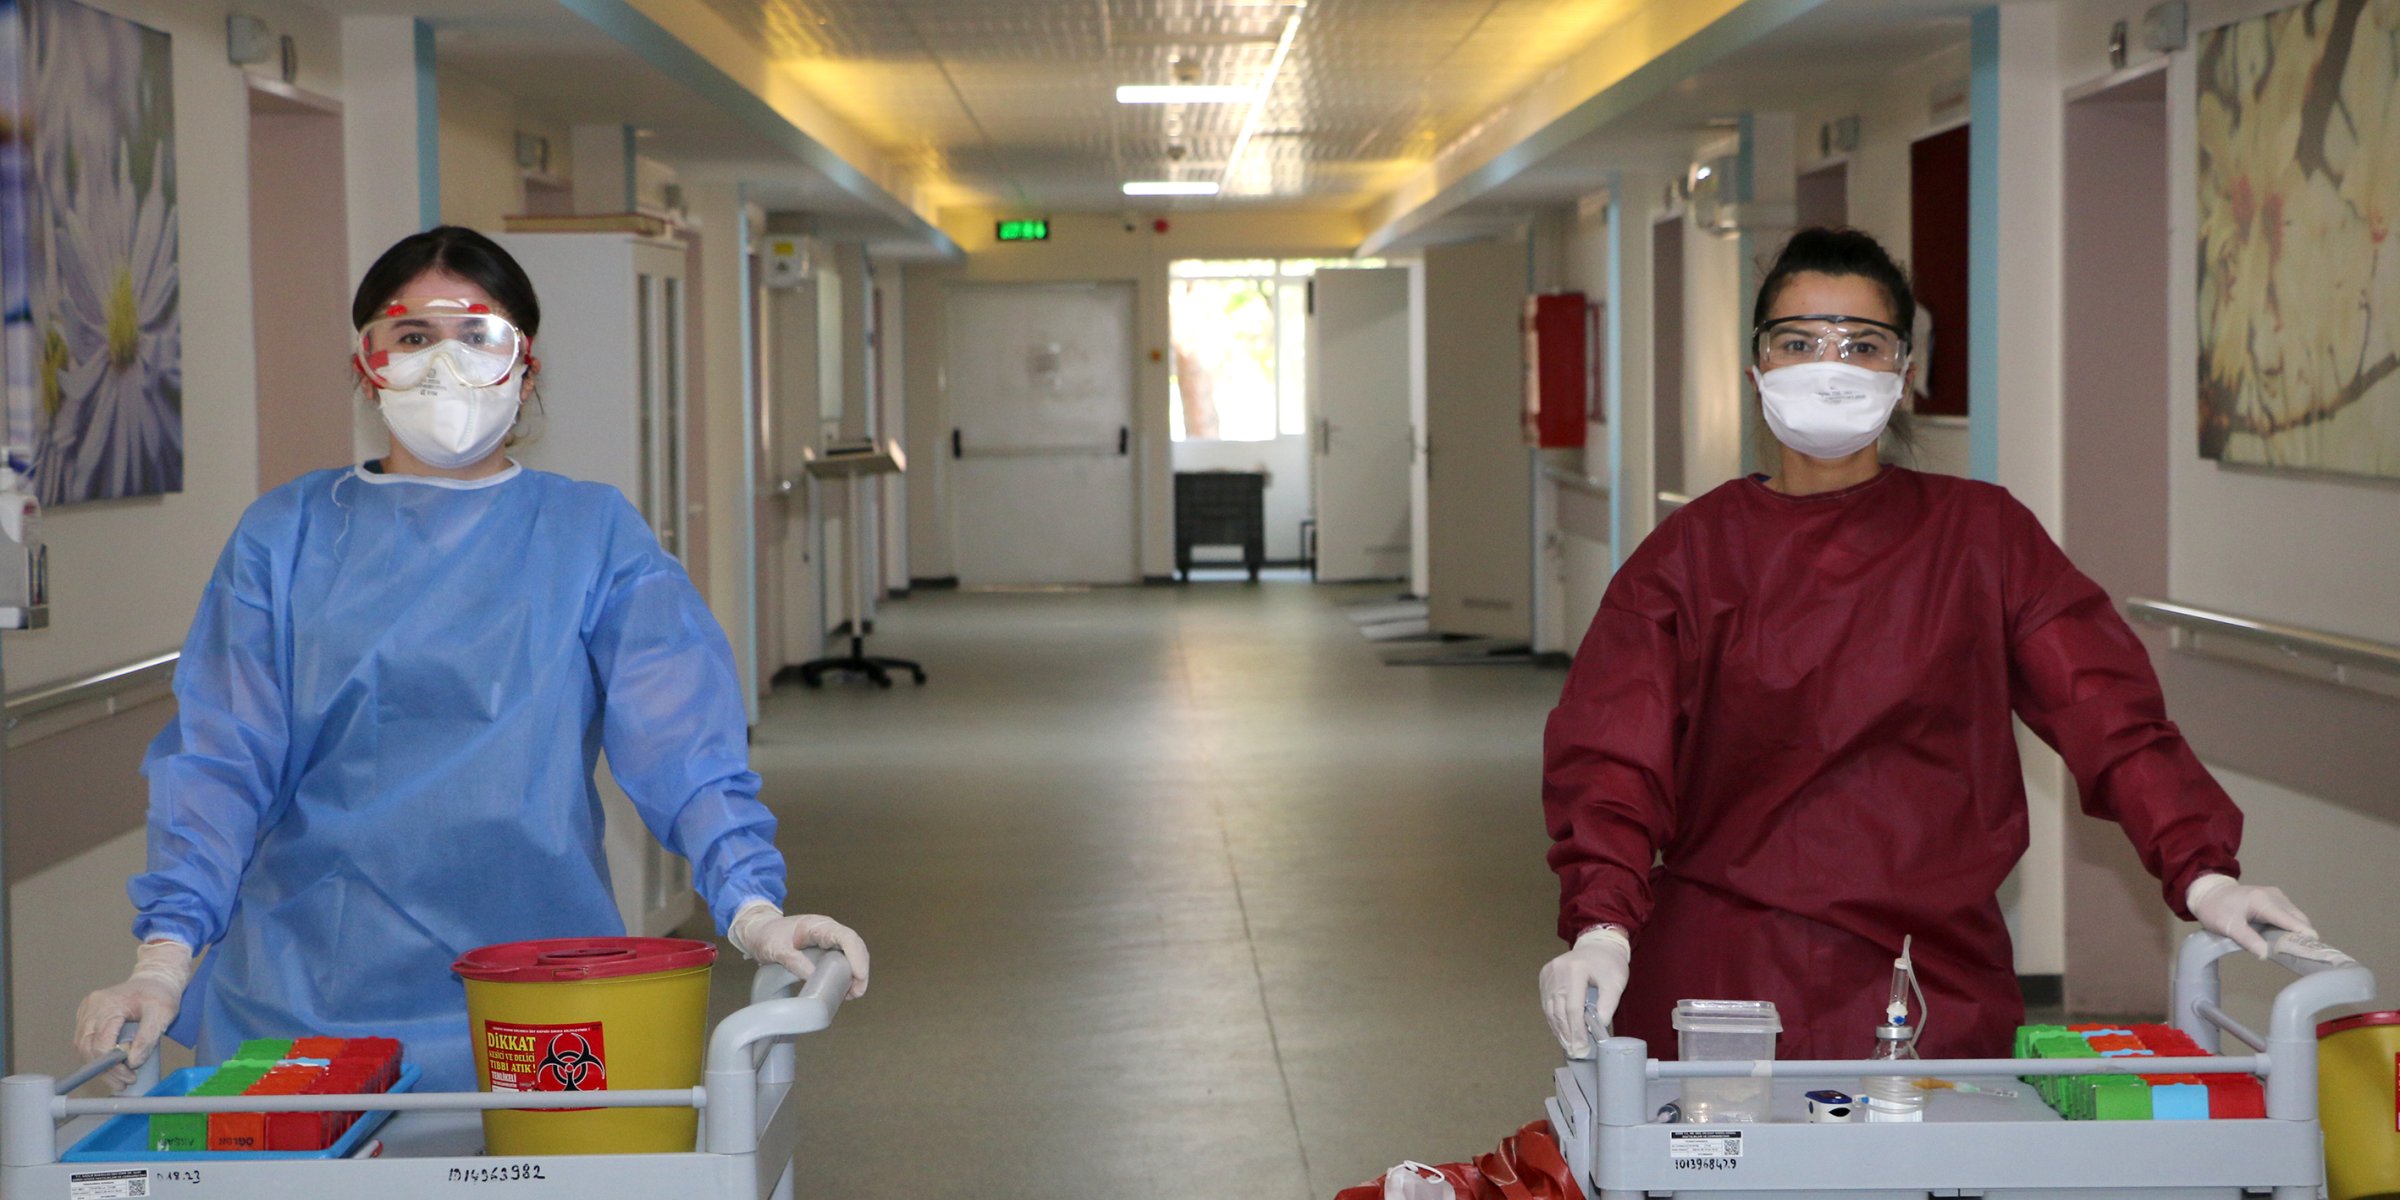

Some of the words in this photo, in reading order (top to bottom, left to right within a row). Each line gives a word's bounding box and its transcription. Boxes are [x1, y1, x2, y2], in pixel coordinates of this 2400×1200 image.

[487, 1032, 536, 1052] DİKKAT
[506, 1053, 514, 1061] VE
[514, 1053, 535, 1062] DELİCİ
[511, 1063, 531, 1073] ATIK
